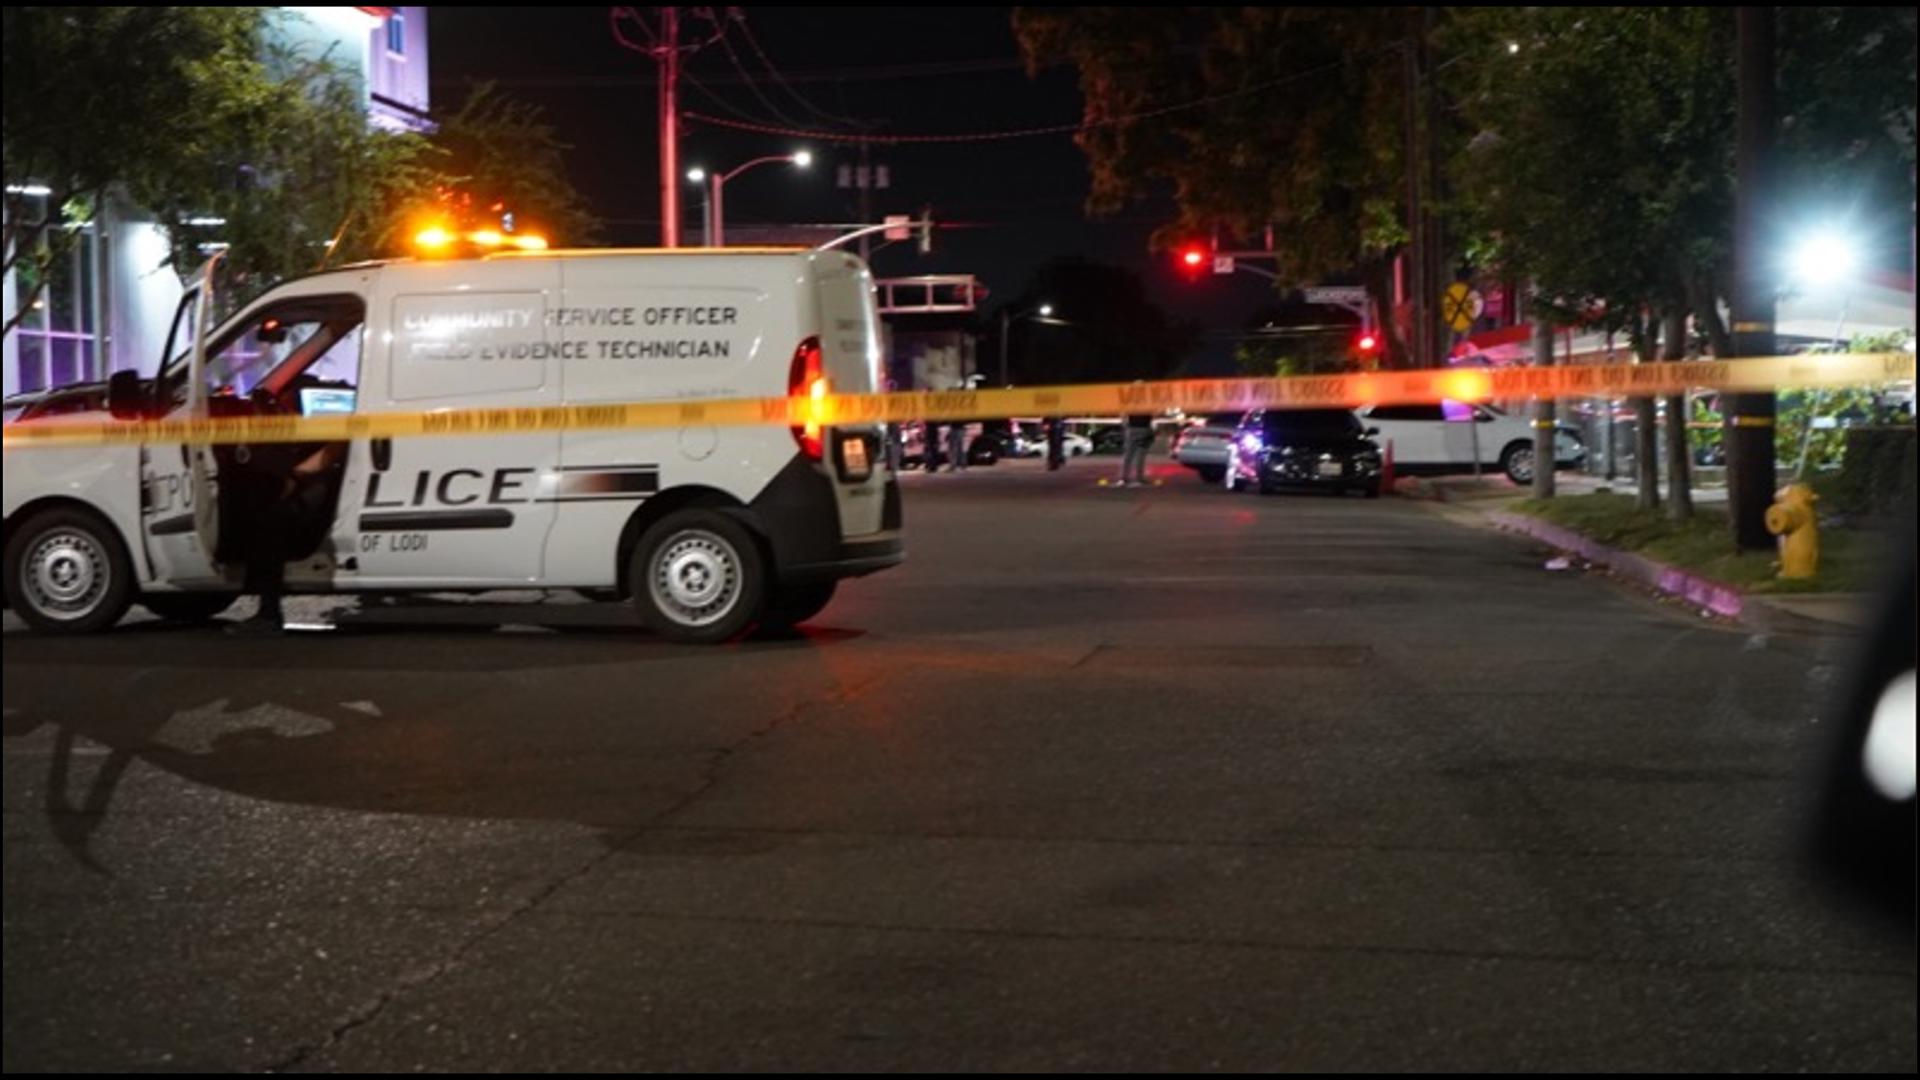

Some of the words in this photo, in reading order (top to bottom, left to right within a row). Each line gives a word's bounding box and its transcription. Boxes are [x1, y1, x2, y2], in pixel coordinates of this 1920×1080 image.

[545, 307, 635, 327] SERVICE
[644, 306, 738, 326] OFFICER
[479, 341, 588, 361] EVIDENCE
[597, 340, 731, 360] TECHNICIAN
[364, 466, 535, 507] LICE
[360, 534, 382, 552] OF
[389, 534, 428, 552] LODI
